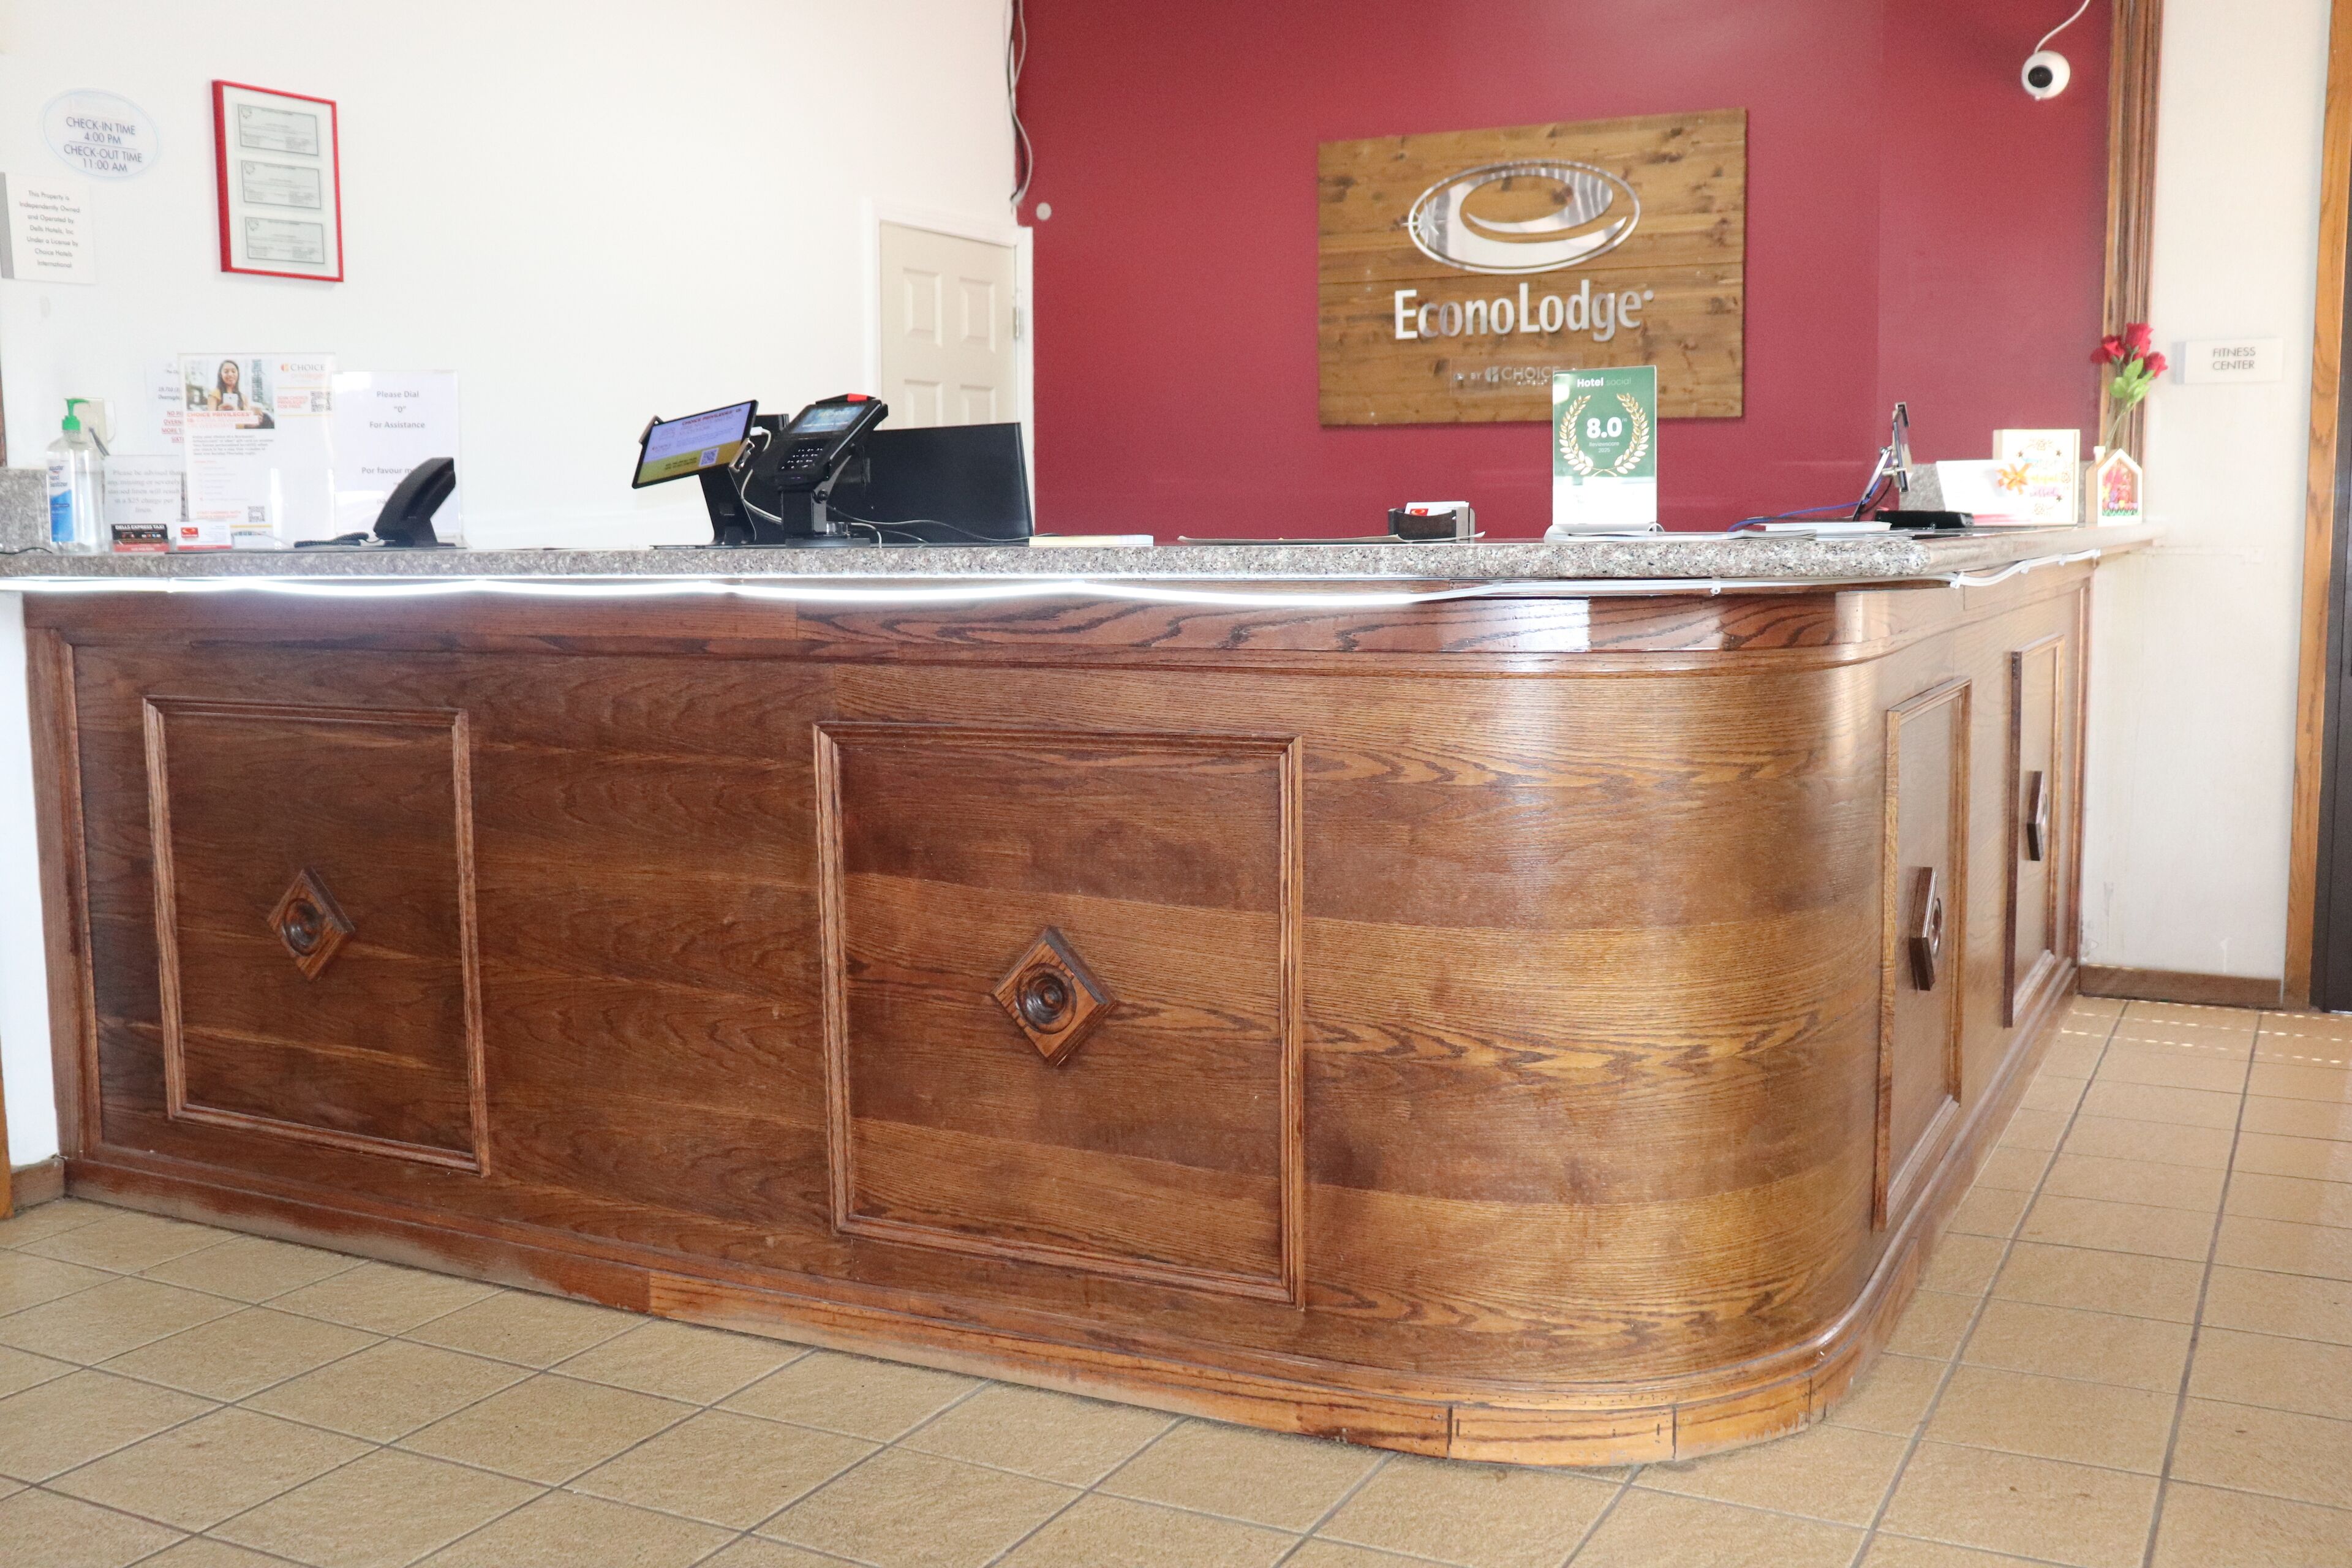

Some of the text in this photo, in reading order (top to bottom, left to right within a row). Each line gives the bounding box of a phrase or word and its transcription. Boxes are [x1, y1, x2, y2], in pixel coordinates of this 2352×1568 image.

[66, 116, 136, 135] CHECK-IN TIME
[107, 134, 122, 145] PM
[64, 144, 142, 162] CHECK-OUT TIME
[83, 158, 127, 172] 11:00 AM
[40, 192, 63, 201] Property
[20, 201, 58, 212] Independently
[40, 214, 66, 223] Operated
[37, 260, 72, 269] International
[1395, 279, 1643, 342] EconoLodge
[2213, 347, 2256, 358] FITNESS
[290, 363, 325, 372] CHOICE
[2212, 360, 2255, 371] CENTER
[1577, 377, 1631, 387] Hotel social
[1586, 417, 1623, 439] 8.0
